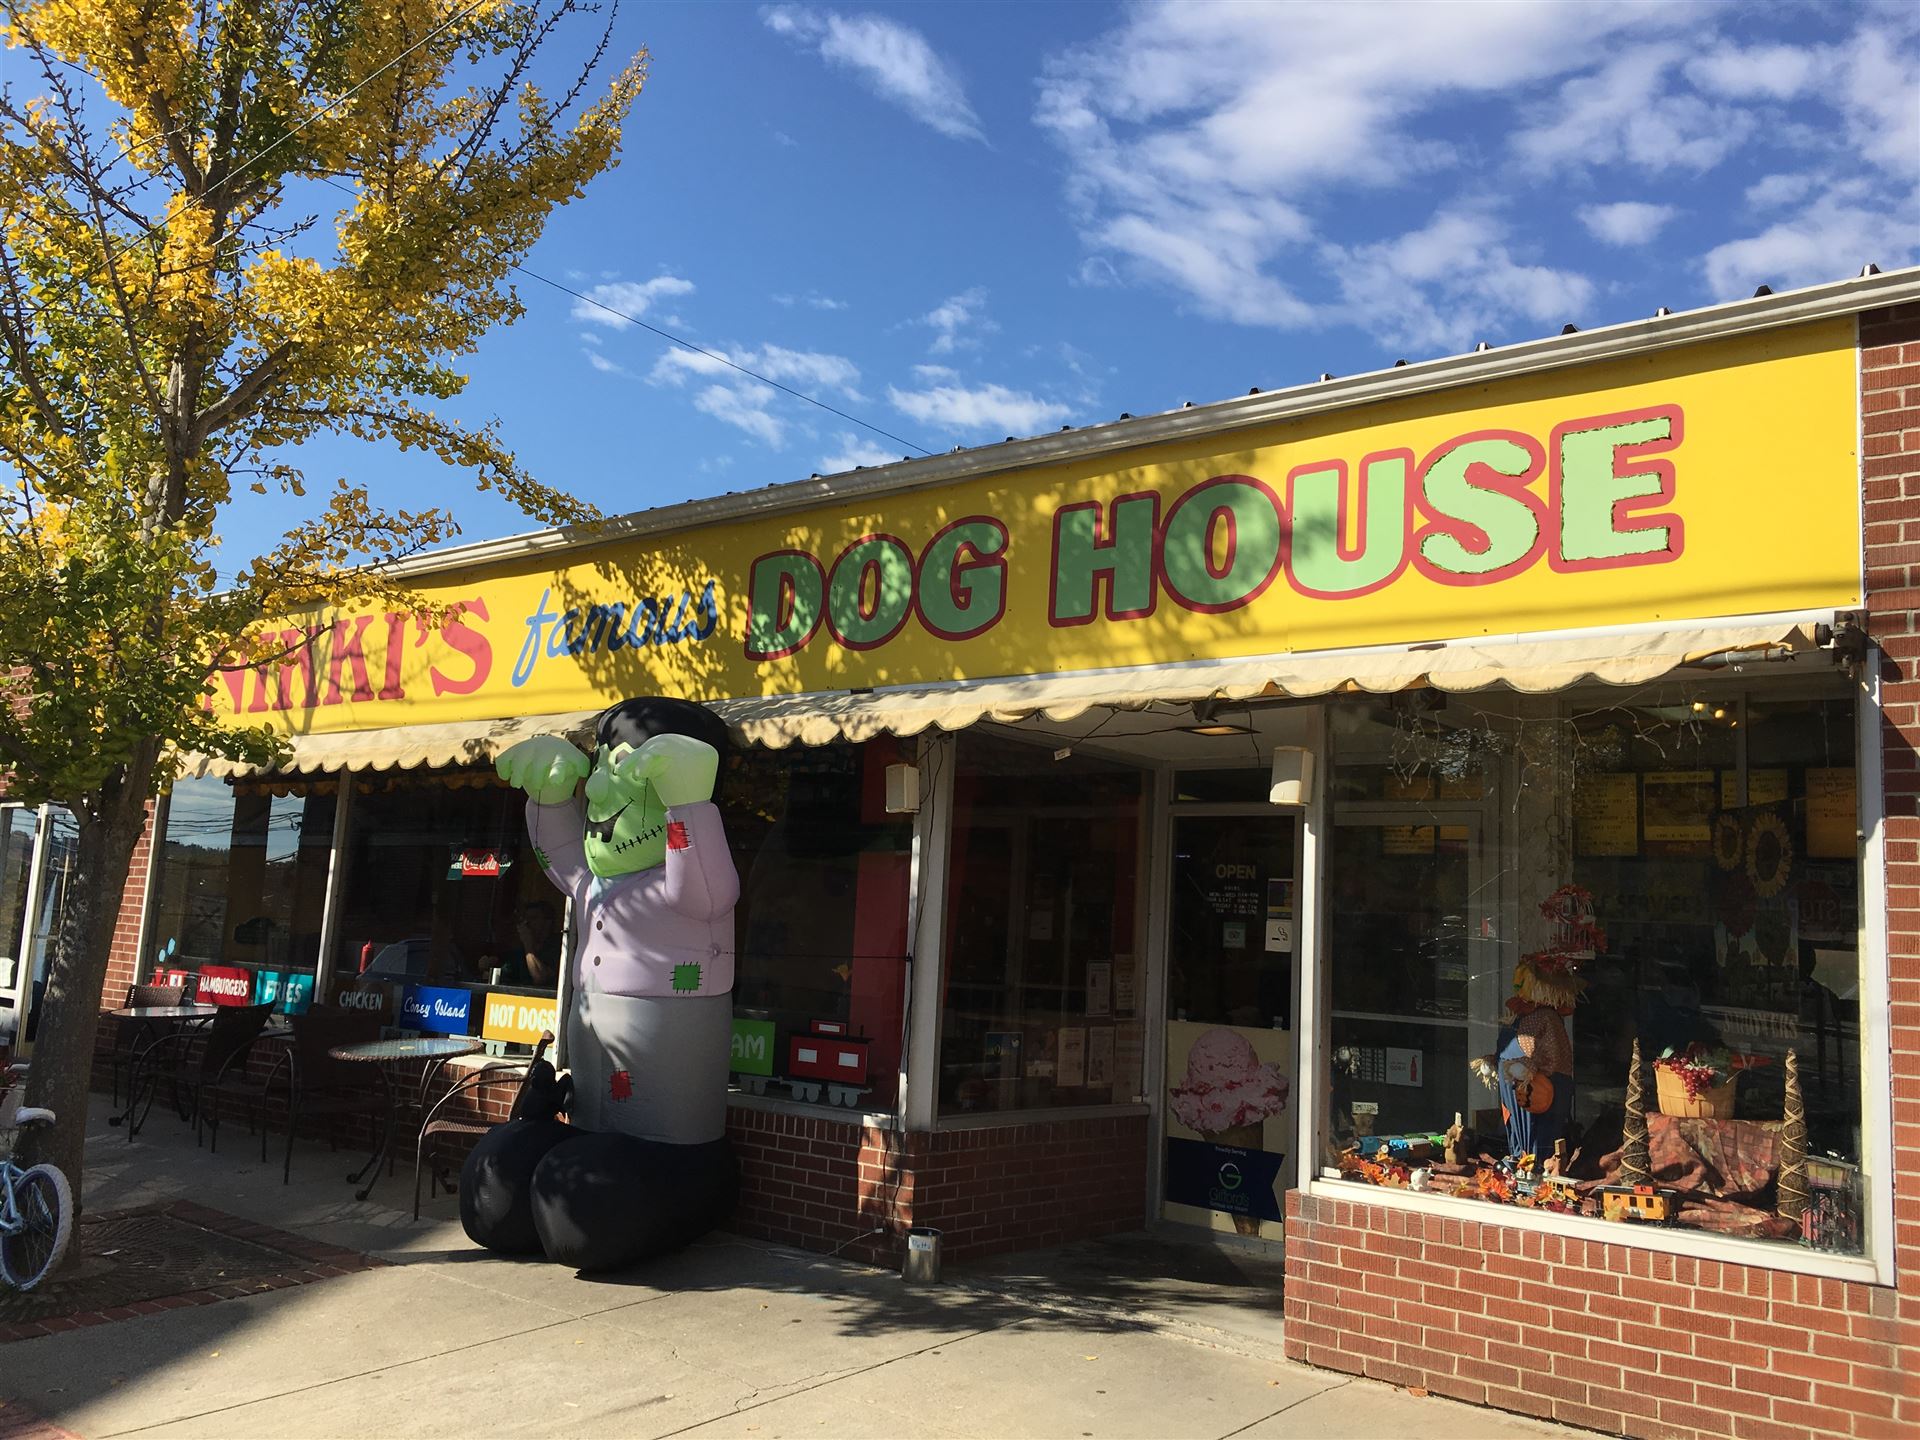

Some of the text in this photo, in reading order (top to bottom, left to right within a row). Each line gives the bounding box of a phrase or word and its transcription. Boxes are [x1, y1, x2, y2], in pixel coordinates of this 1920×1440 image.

[511, 579, 717, 687] famous
[745, 515, 1009, 661] DOG
[1048, 404, 1684, 628] HOUSE
[1215, 864, 1256, 879] OPEN
[199, 975, 248, 997] HAMBURGERS
[265, 979, 302, 1003] FRIES
[339, 990, 383, 1011] CHICKEN
[403, 996, 467, 1019] Coney Island
[488, 1003, 557, 1032] HOT DOGS
